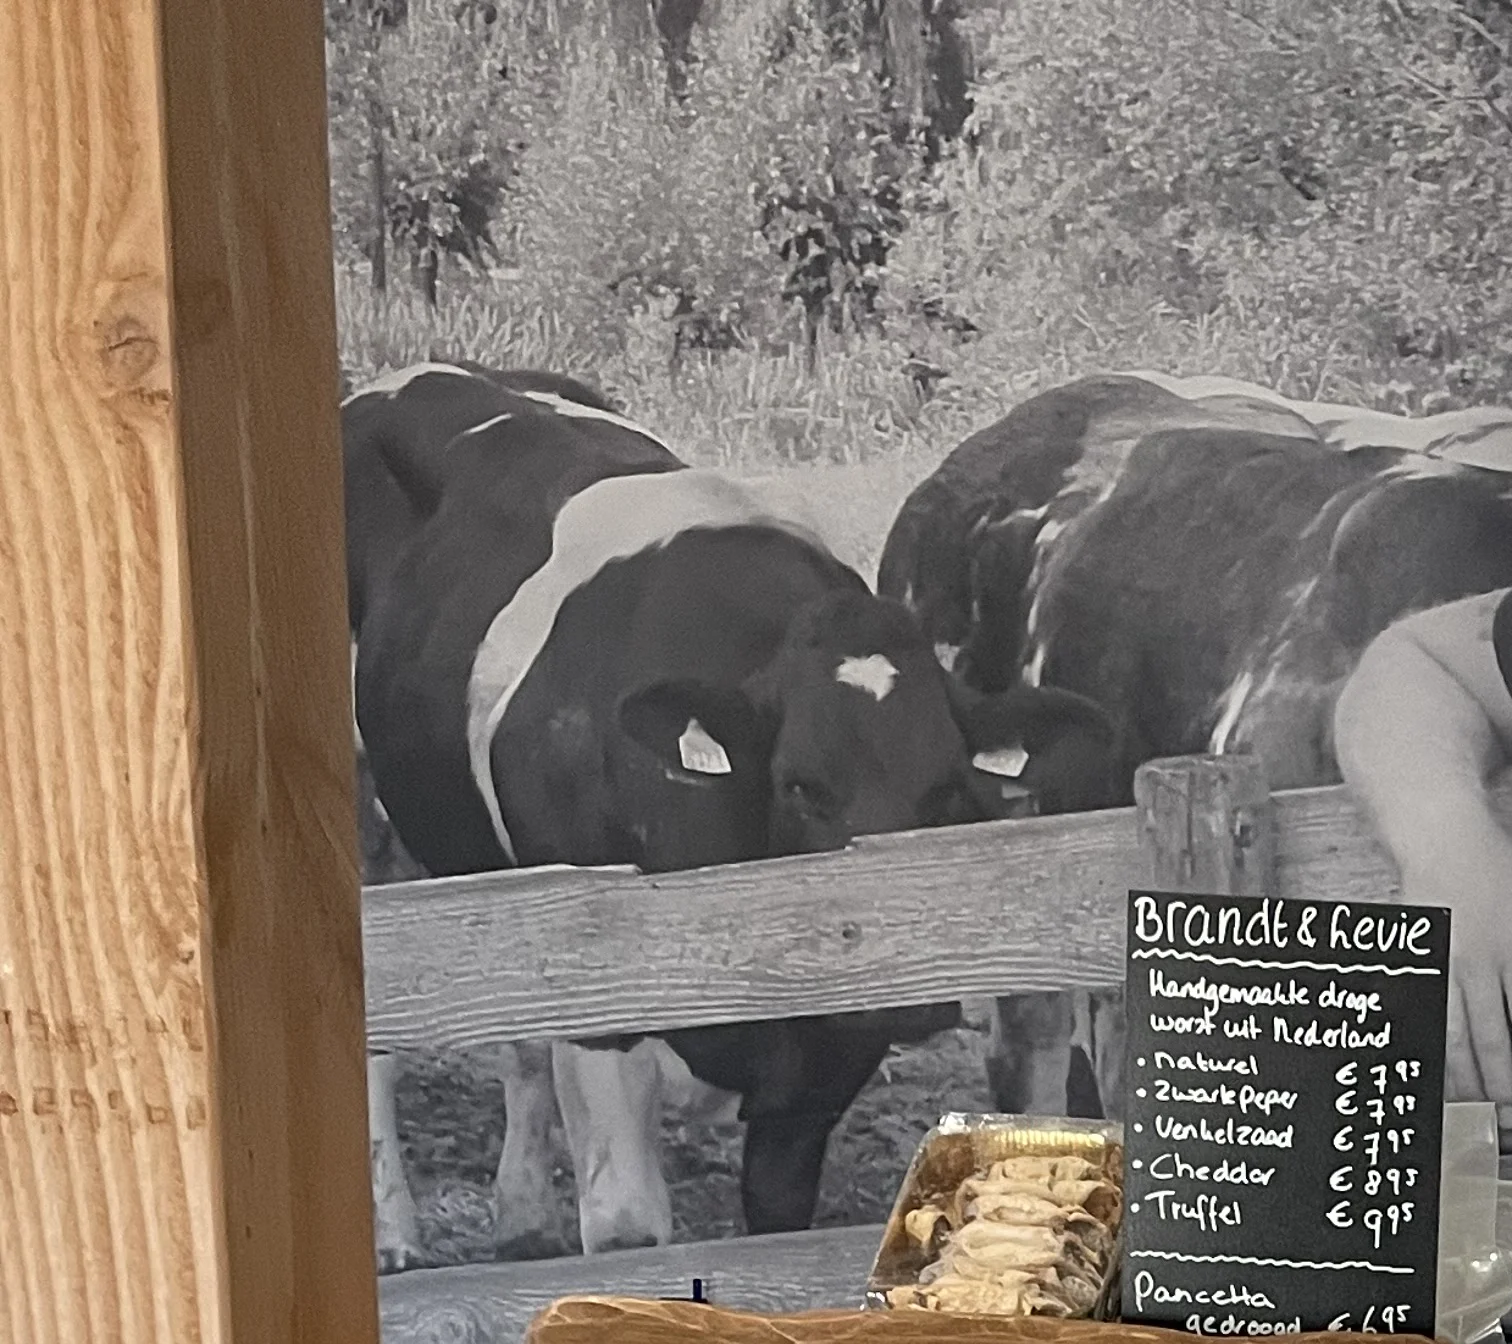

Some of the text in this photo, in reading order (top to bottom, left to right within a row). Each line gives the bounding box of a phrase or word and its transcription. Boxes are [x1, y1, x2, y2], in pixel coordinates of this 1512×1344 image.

[1135, 896, 1288, 947] Brandt
[1297, 906, 1318, 946] &
[1319, 981, 1382, 1023] droge
[1151, 1007, 1216, 1035] worst
[1224, 1015, 1262, 1039] uit
[1156, 1115, 1293, 1148] Venkelzaad
[1150, 1153, 1275, 1186] Cheddar
[1145, 1191, 1241, 1231] Truffel
[1135, 1270, 1275, 1312] Pancetta
